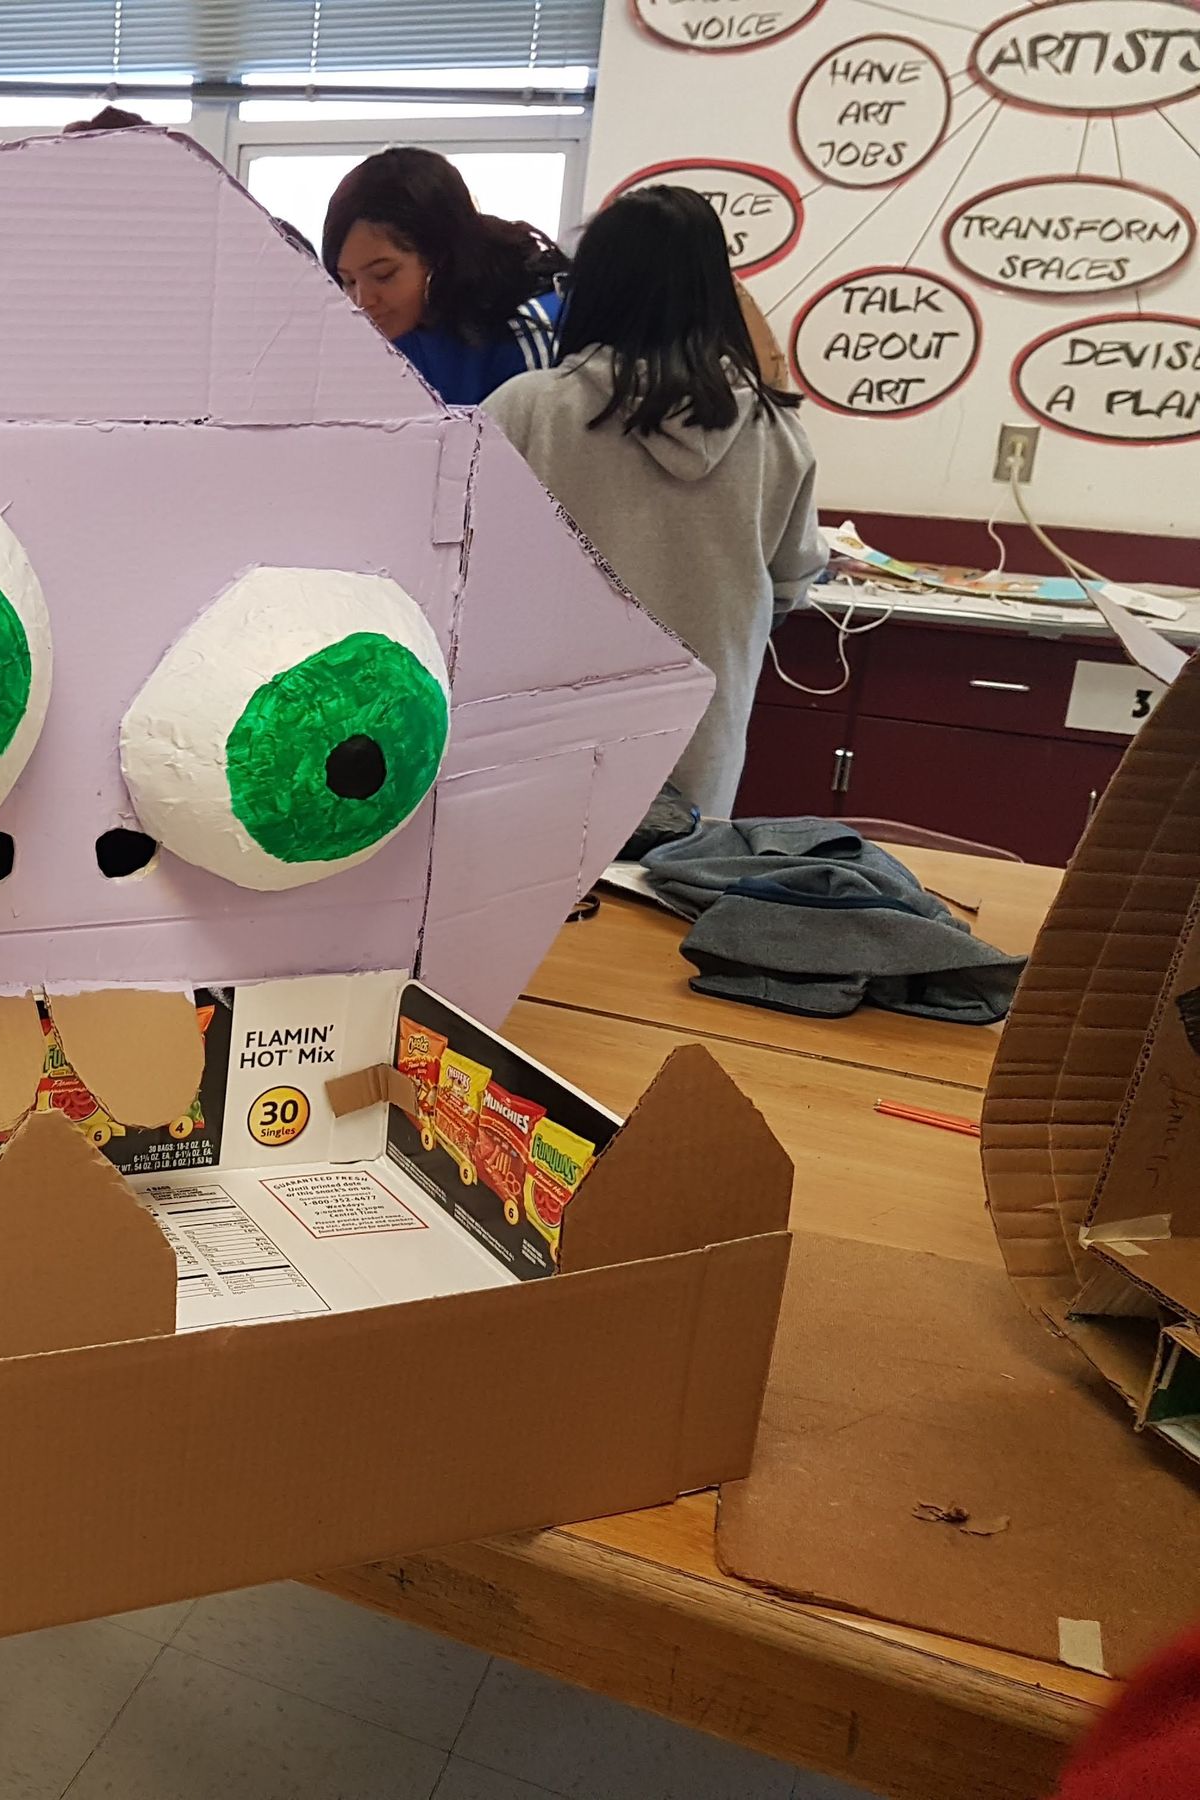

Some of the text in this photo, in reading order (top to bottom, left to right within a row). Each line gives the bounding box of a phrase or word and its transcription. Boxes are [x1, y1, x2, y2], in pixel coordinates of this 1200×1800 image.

[683, 12, 783, 41] VOICE
[829, 58, 927, 86] HAVE
[836, 100, 906, 126] ART
[817, 140, 908, 168] JOBS
[702, 191, 780, 216] TICE
[962, 214, 1181, 243] TRANSFORM
[999, 254, 1131, 282] SPACES
[842, 286, 943, 315] TALK
[823, 331, 960, 362] ABOUT
[848, 377, 926, 405] ART
[1045, 385, 1075, 413] A
[1132, 688, 1154, 719] 3
[245, 1024, 334, 1049] FLAMIN'
[408, 1035, 430, 1056] Cheetos
[298, 1046, 335, 1065] Mix
[259, 1099, 299, 1126] 30
[482, 1089, 530, 1135] MUNCHIES
[94, 1131, 103, 1142] 6
[175, 1122, 184, 1133] 4
[260, 1127, 296, 1139] Singles
[424, 1134, 430, 1145] 8
[148, 1145, 157, 1154] 30
[531, 1132, 581, 1186] FUNYUNS
[462, 1167, 469, 1179] 6
[509, 1207, 514, 1218] 6
